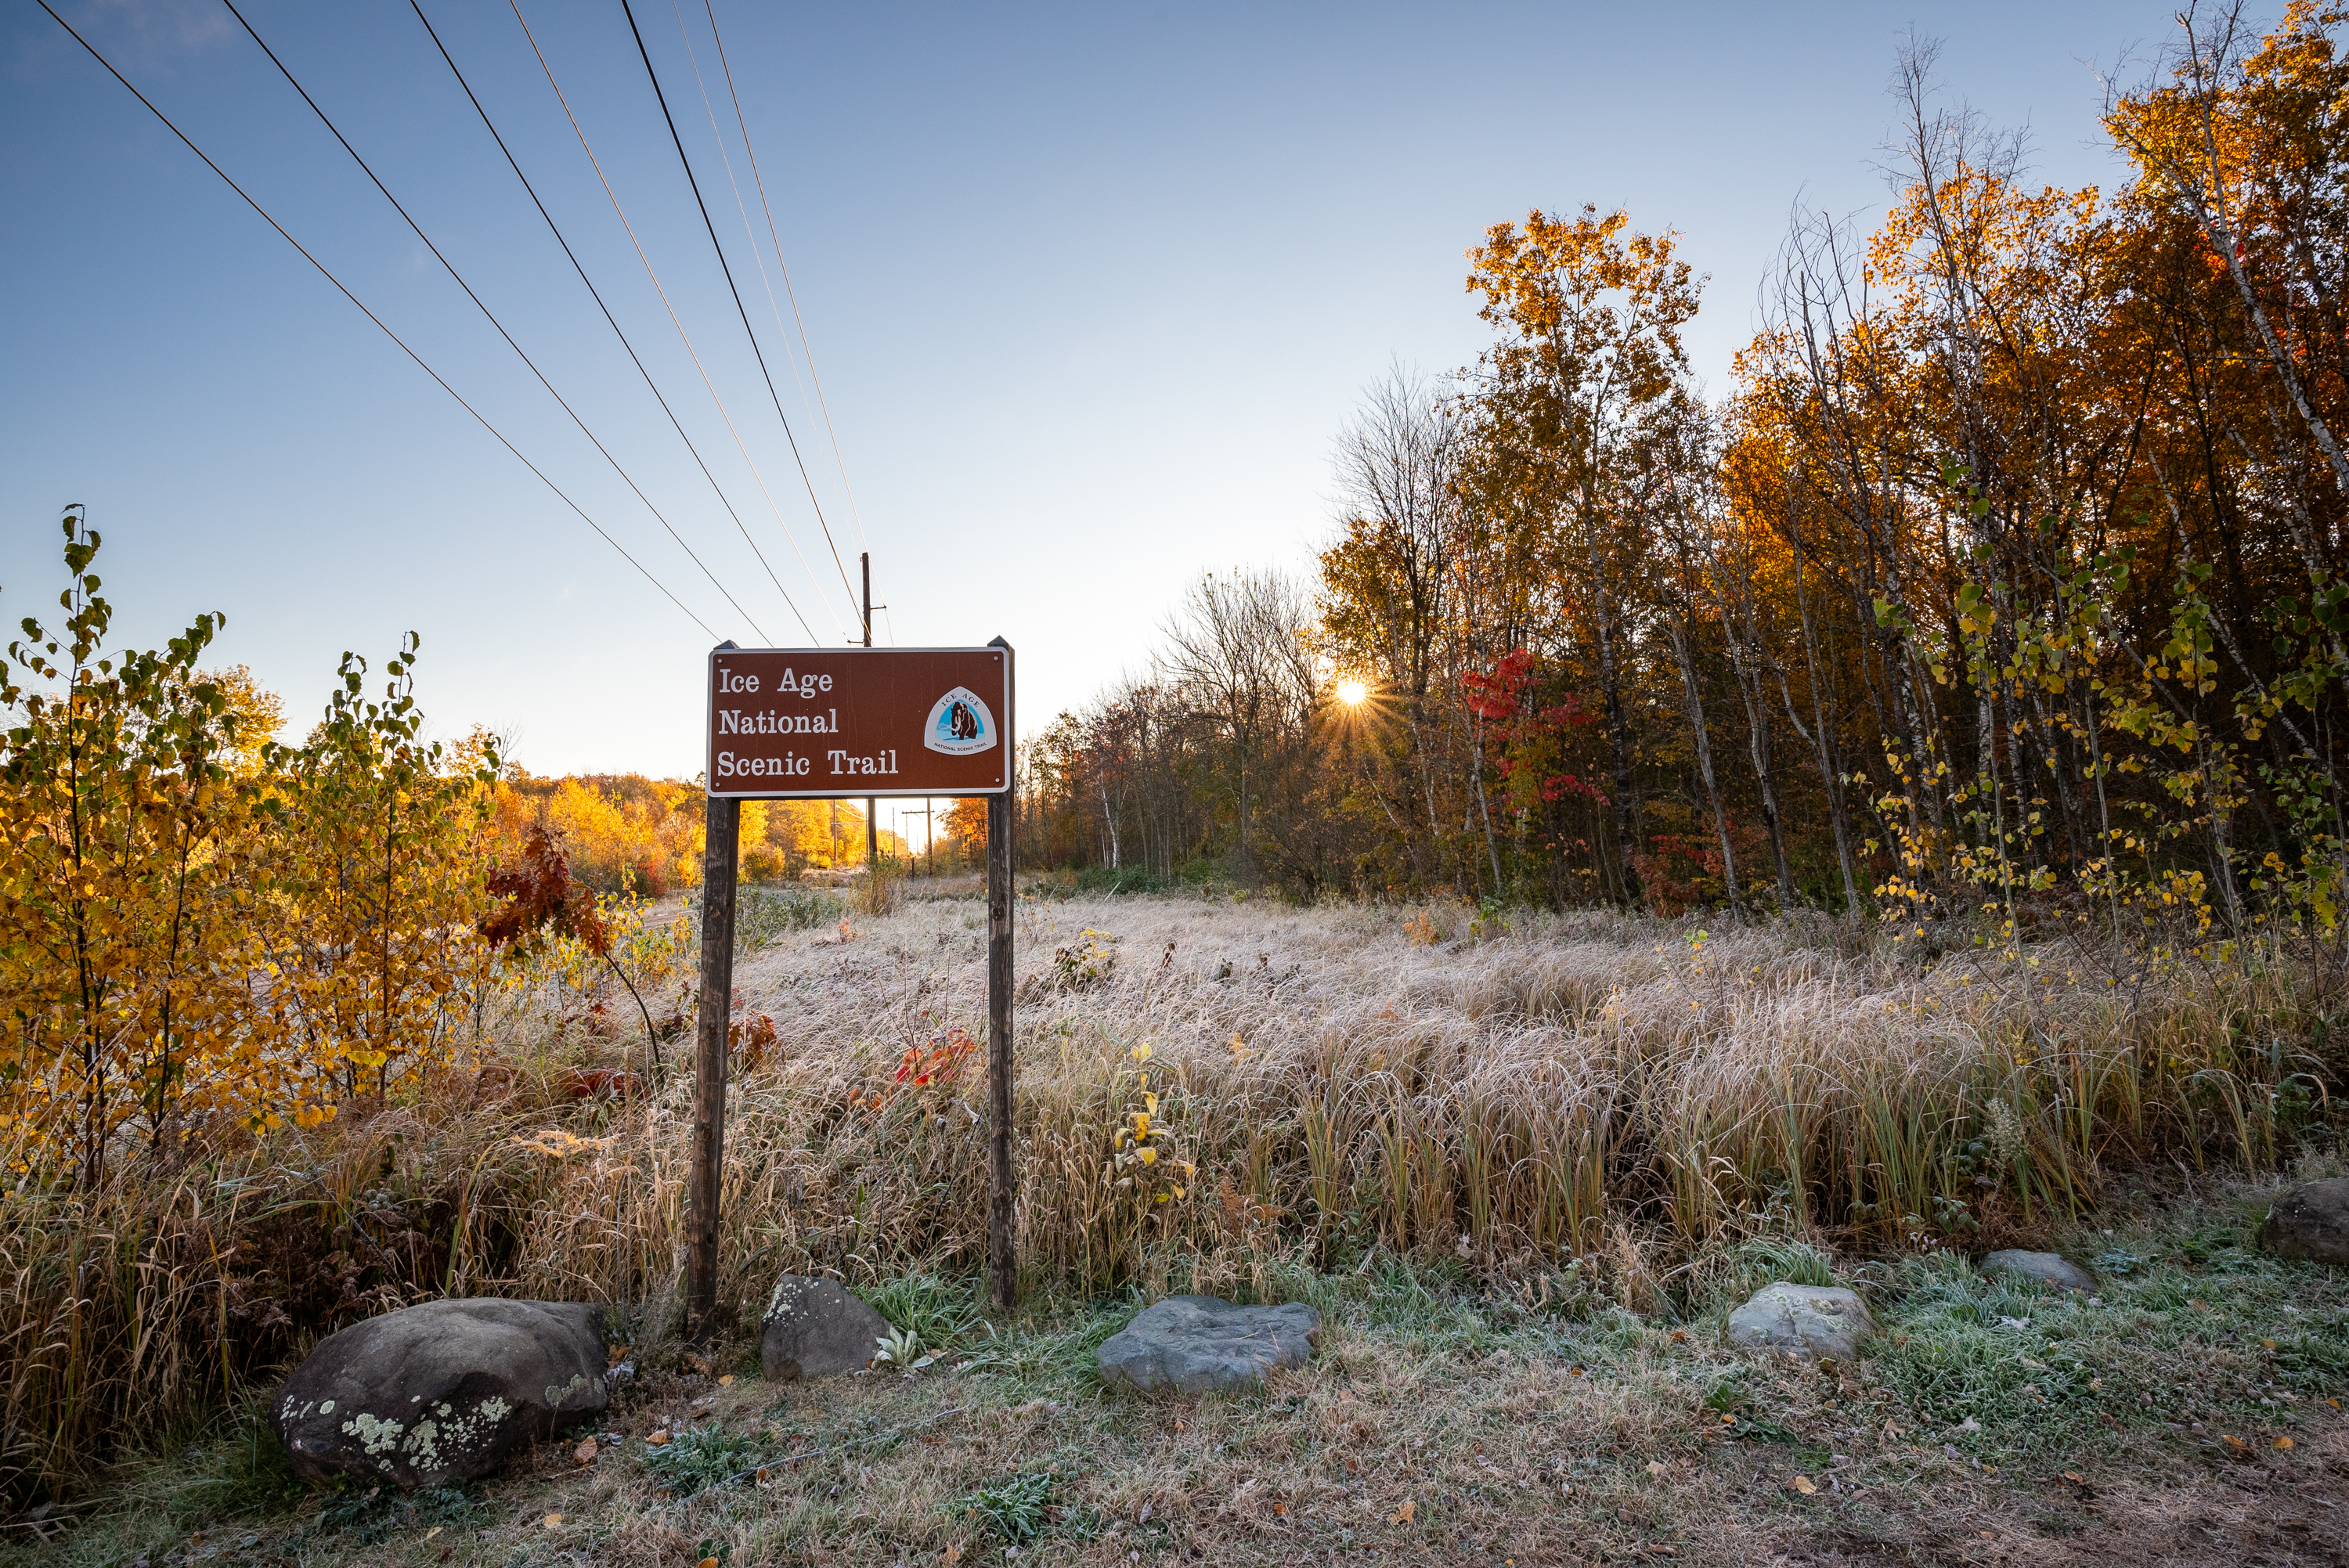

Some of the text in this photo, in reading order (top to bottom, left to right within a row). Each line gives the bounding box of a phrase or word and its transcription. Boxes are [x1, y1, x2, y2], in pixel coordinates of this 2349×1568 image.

[719, 668, 833, 699] Ice Age
[941, 693, 980, 708] ICE AGE
[718, 708, 839, 734] National
[934, 742, 956, 752] NATIONAL
[717, 749, 898, 777] Scenic Trail
